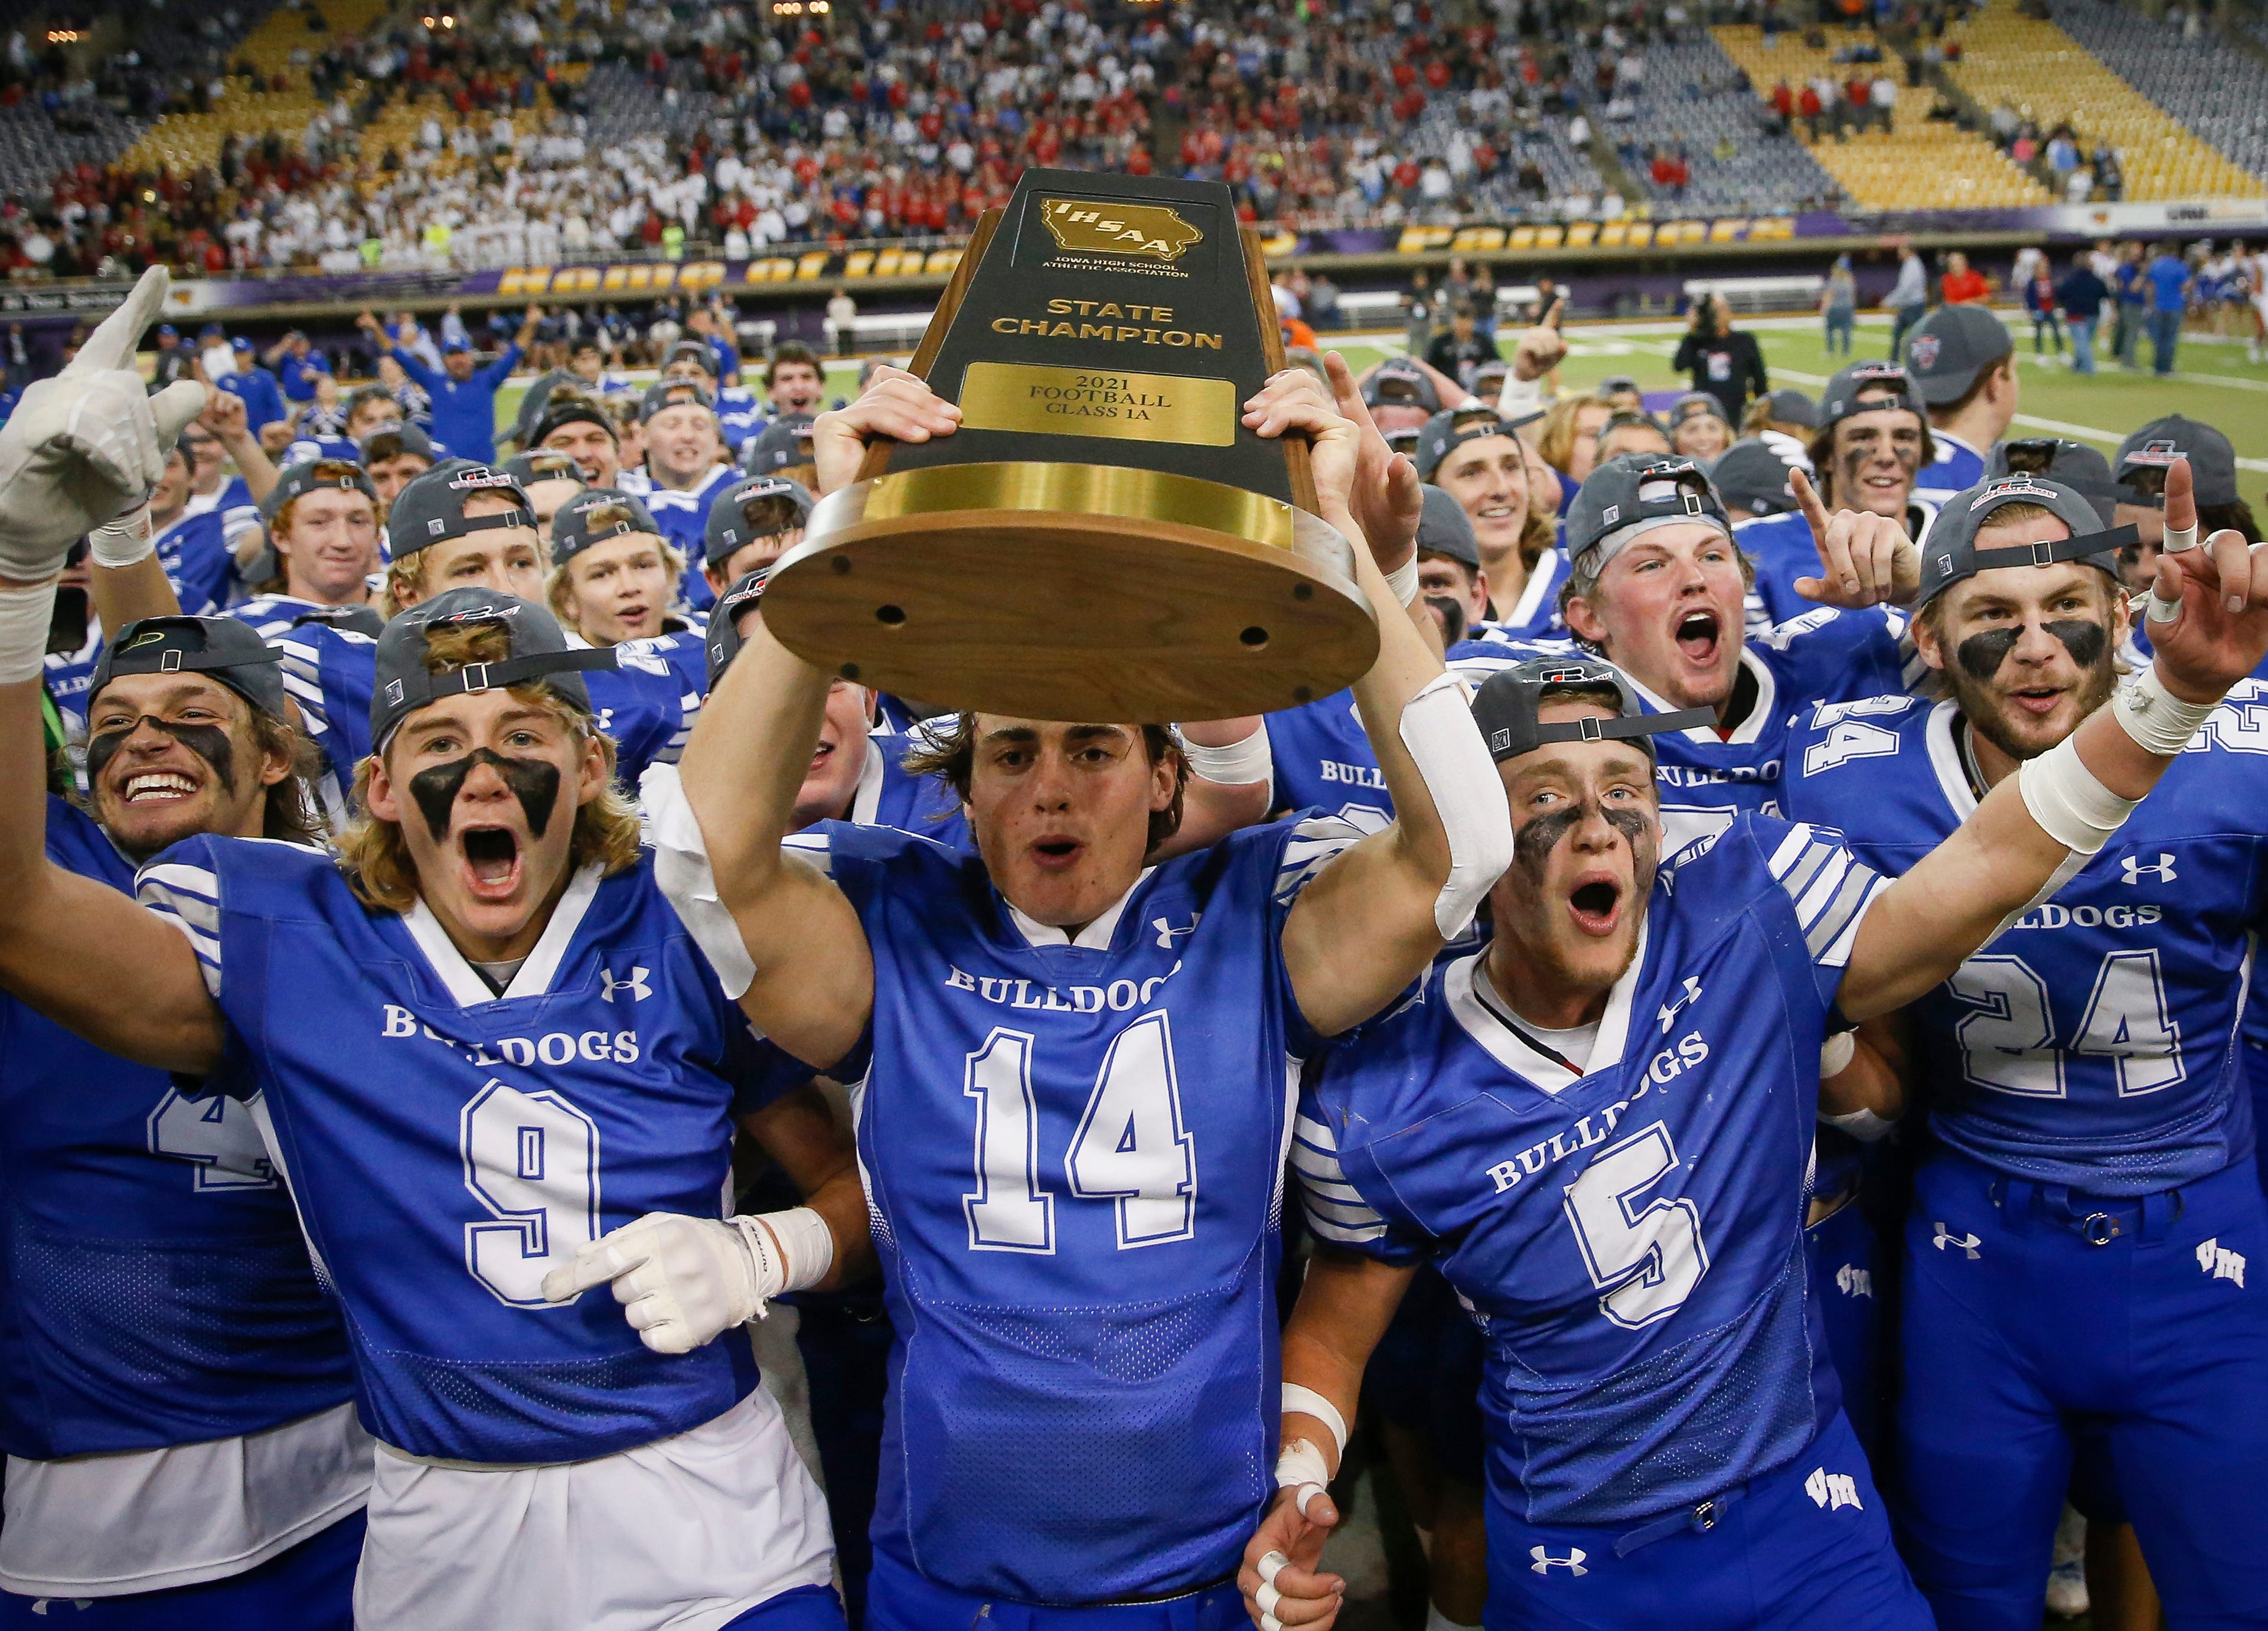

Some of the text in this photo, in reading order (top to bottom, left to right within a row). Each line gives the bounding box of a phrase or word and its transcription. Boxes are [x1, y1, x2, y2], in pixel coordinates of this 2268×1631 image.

[1054, 203, 1170, 252] IHSAA
[1042, 262, 1189, 279] ATHLETIC ASSOCIATION
[1055, 256, 1179, 271] IOWA HIGH SCHOOL
[1047, 298, 1174, 323] STATE
[991, 317, 1223, 350] CHAMPION
[1029, 384, 1172, 408] FOOTBALL
[1076, 375, 1129, 391] 2021
[1045, 402, 1151, 420] CLASS 1A
[381, 1003, 639, 1066] BLDOGS
[1945, 948, 2187, 1099] 24
[962, 1008, 1198, 1255] 14
[459, 1077, 601, 1310] 9
[1562, 1119, 1711, 1330] 5
